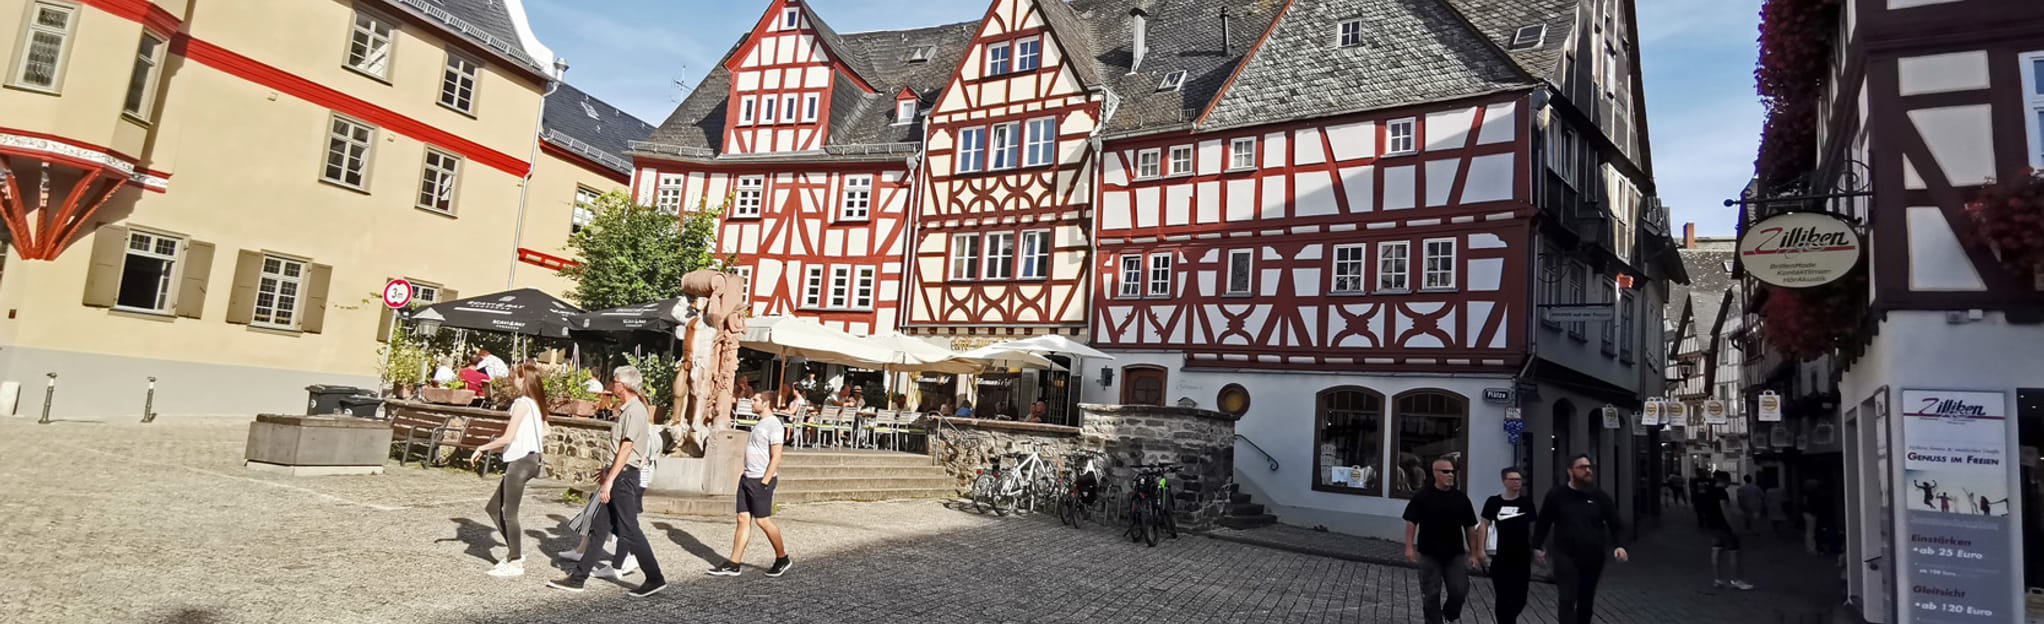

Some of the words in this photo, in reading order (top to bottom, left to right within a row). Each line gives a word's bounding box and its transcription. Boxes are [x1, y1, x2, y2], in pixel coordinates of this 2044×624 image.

[1755, 226, 1849, 252] Zilliken
[1918, 397, 1987, 416] Zilliken
[1938, 548, 1953, 557] 25
[1957, 550, 1983, 559] Euro
[1941, 603, 1964, 614] 120
[1966, 606, 1993, 616] Euro
